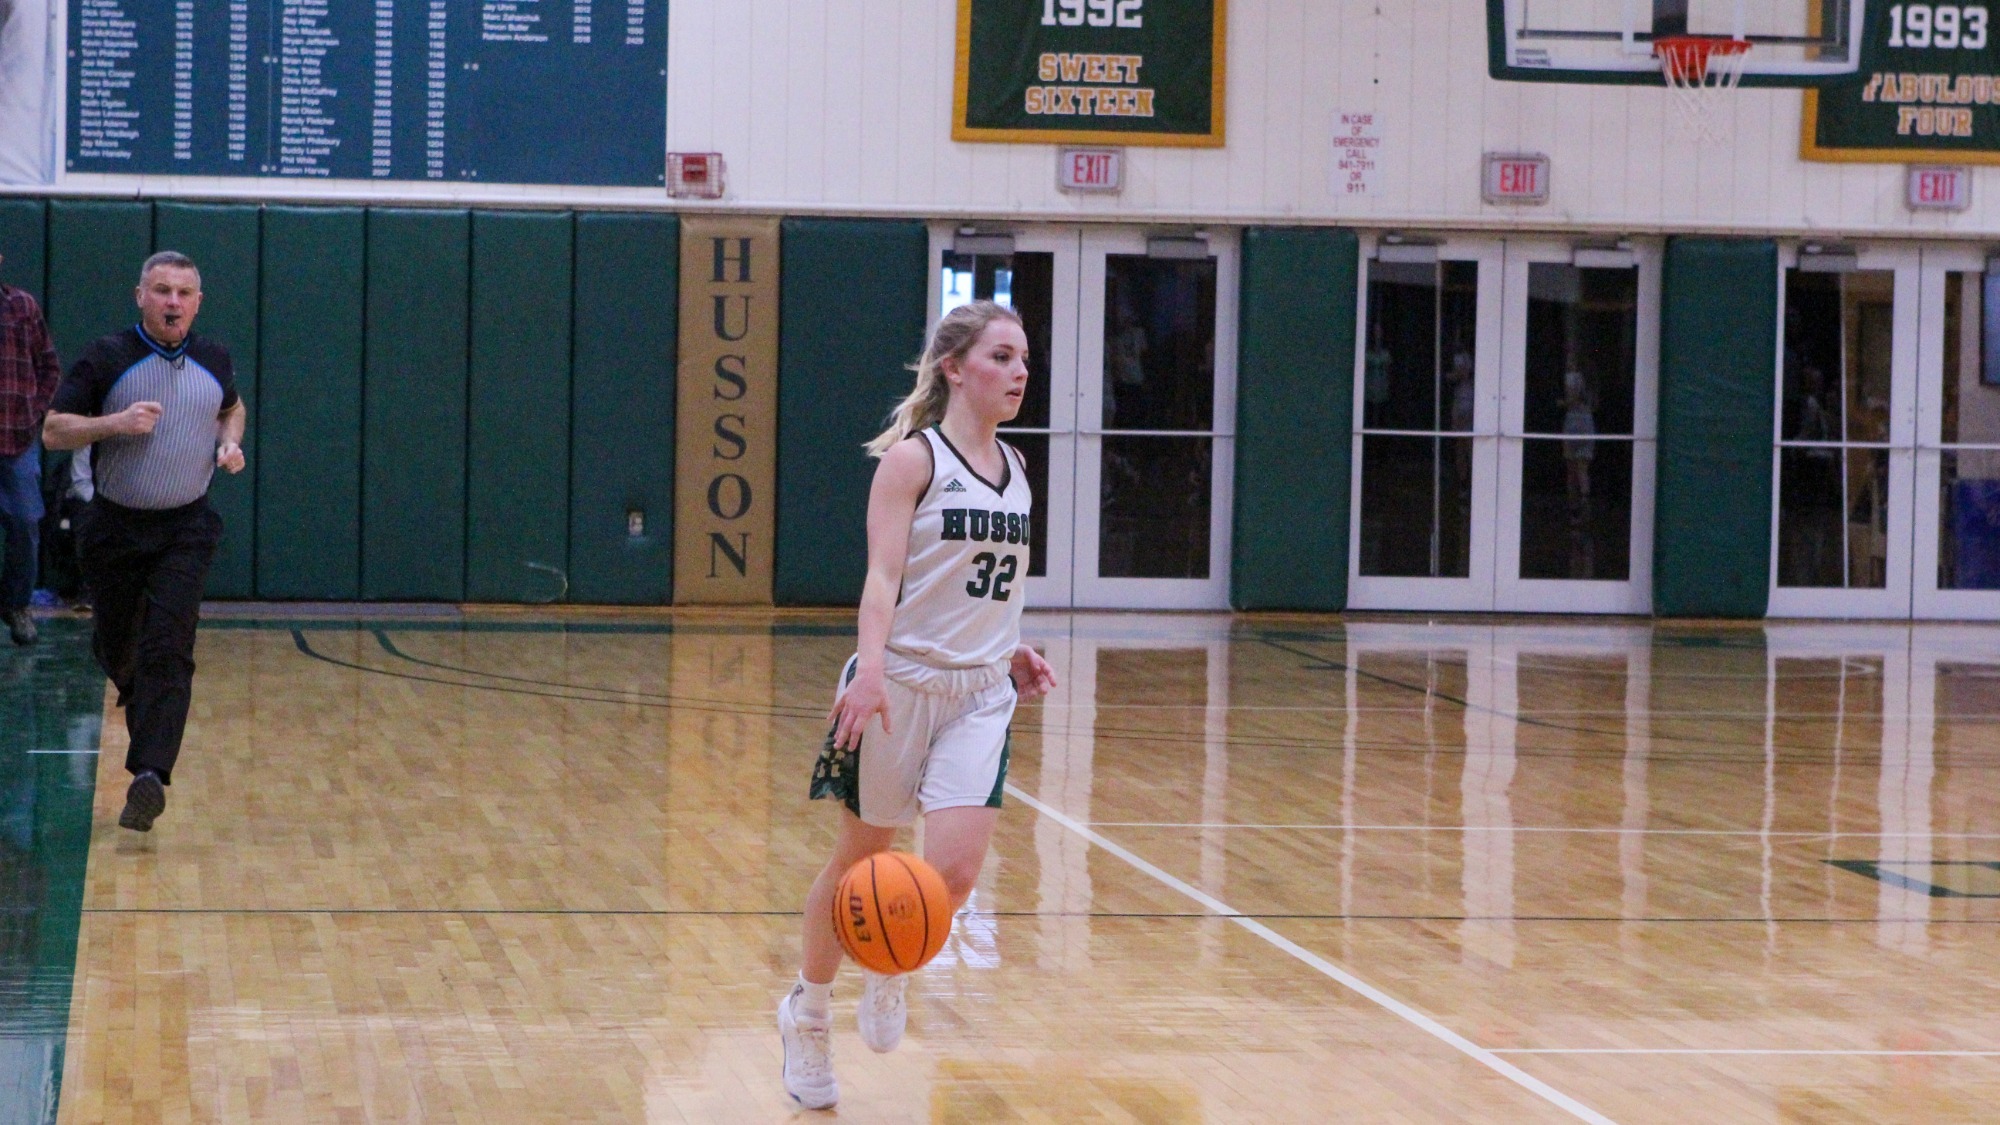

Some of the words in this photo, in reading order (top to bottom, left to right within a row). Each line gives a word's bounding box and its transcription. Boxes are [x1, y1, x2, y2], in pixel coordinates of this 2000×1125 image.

[1041, 0, 1143, 28] 1992
[1888, 5, 1988, 49] 1993
[1038, 53, 1142, 83] SWEET
[1025, 86, 1154, 117] SIXTEEN
[281, 116, 305, 126] Randy
[1342, 114, 1350, 124] IN
[1351, 114, 1373, 125] CASE
[1897, 107, 1973, 136] FOUR
[281, 126, 300, 135] Ryan
[1351, 126, 1362, 136] OF
[281, 136, 306, 144] Robert
[1333, 137, 1379, 147] EMERGENCY
[281, 146, 305, 155] Buddy
[1346, 149, 1367, 159] CALL
[304, 167, 329, 176] Harvey
[1073, 154, 1112, 184] EXIT
[1350, 171, 1362, 181] OR
[1500, 163, 1536, 193] EXIT
[1346, 182, 1366, 193] 911
[1919, 170, 1957, 201] EXIT
[705, 237, 755, 578] HUSSON
[966, 552, 1018, 602] 32
